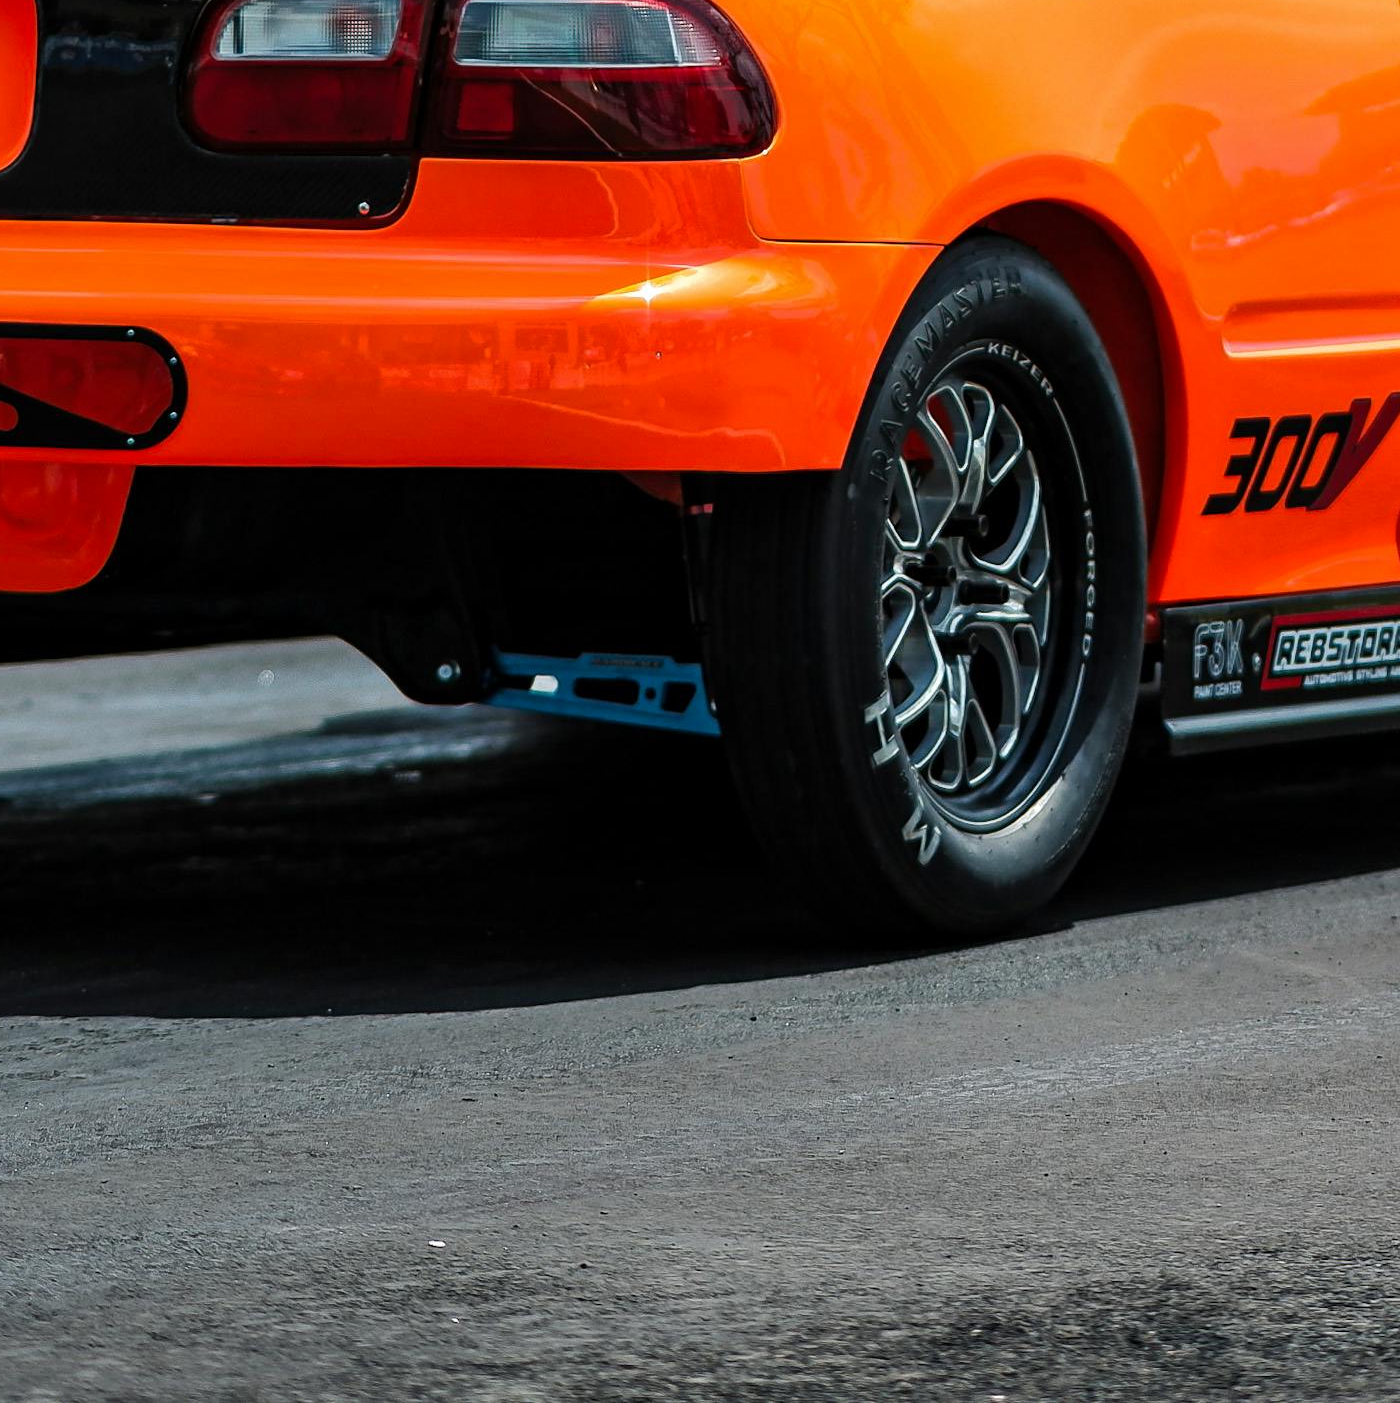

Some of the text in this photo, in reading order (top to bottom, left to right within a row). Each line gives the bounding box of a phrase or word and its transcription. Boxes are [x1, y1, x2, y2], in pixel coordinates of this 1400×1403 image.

[870, 265, 1022, 484] RACEMASTER
[987, 342, 1055, 397] KEIZER
[1084, 509, 1096, 656] FORGED
